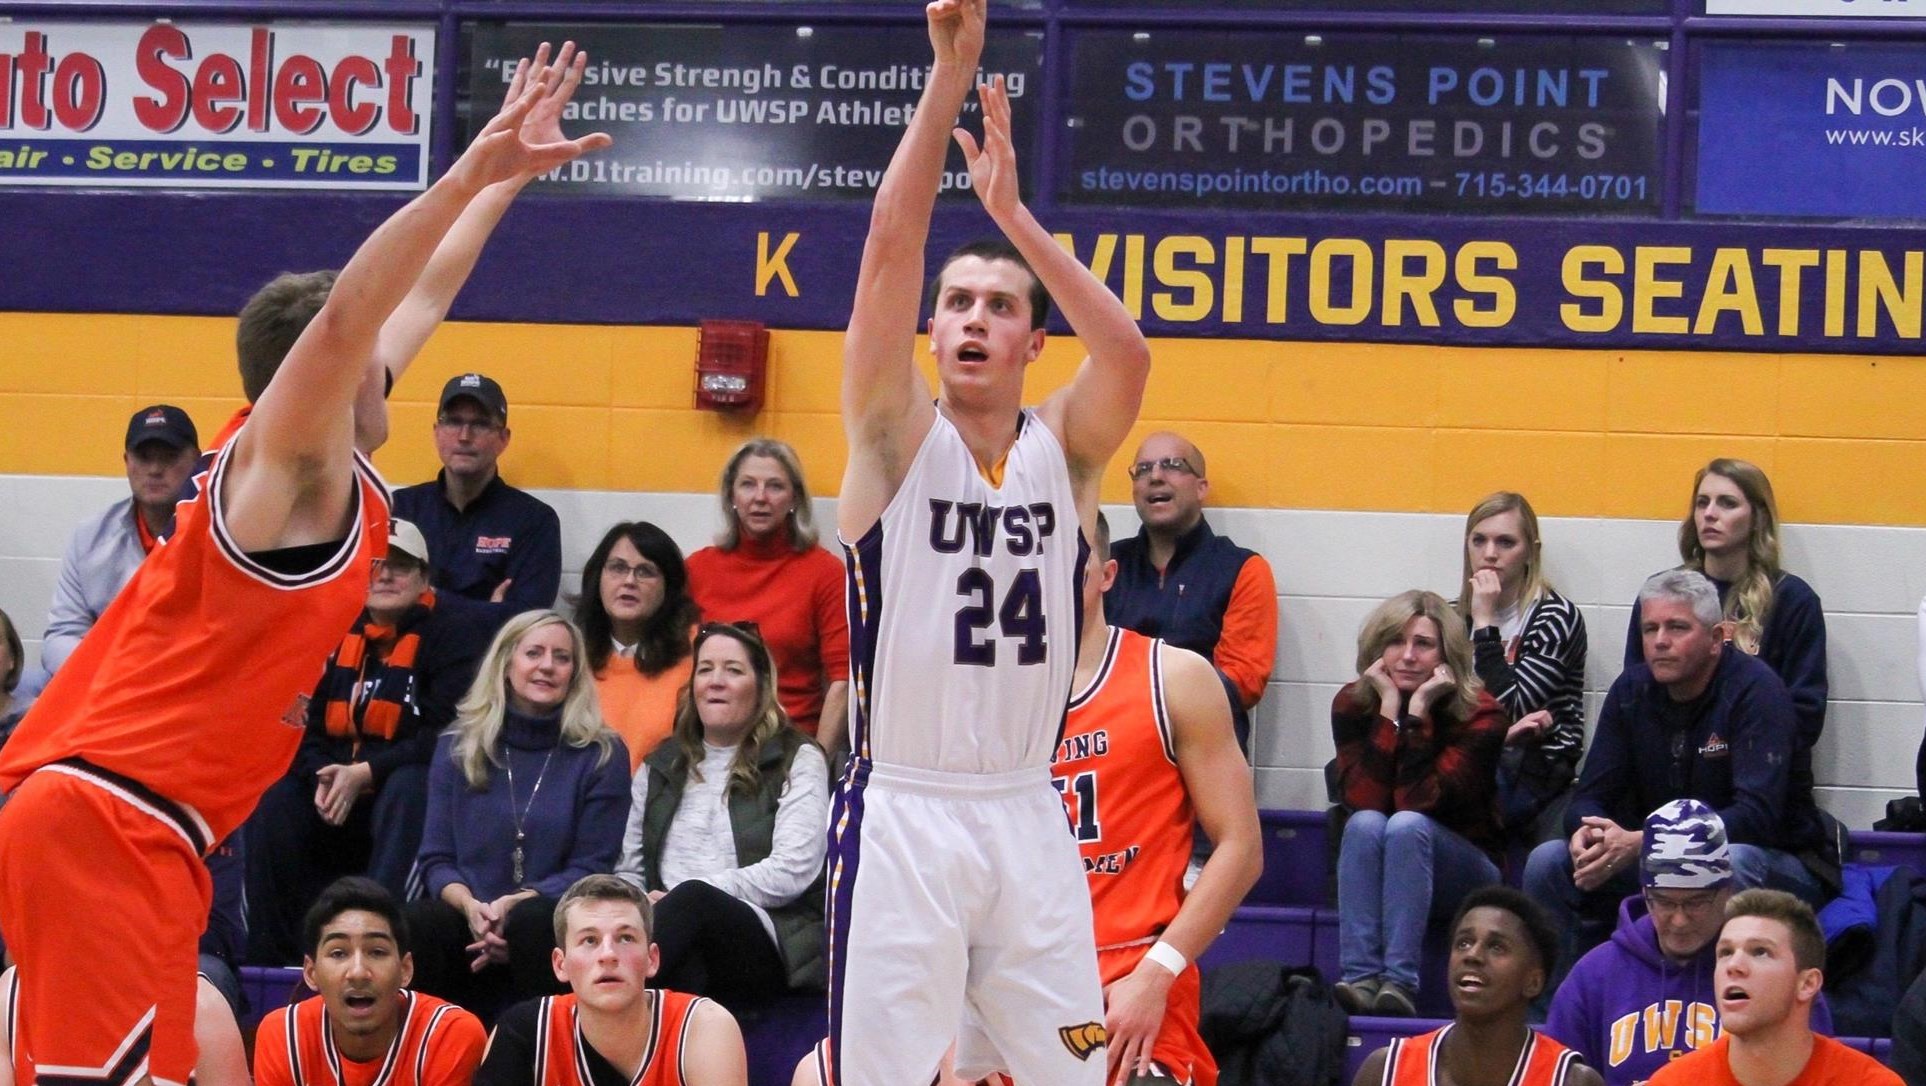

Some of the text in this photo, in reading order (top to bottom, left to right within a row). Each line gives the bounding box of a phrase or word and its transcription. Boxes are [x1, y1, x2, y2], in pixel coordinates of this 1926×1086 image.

[0, 23, 422, 135] to Select
[655, 62, 781, 94] Strengh
[790, 65, 812, 88] &
[820, 65, 1025, 97] Conditiing
[1124, 62, 1608, 107] STEVENS POINT
[1826, 77, 1926, 116] NO
[562, 96, 653, 121] aches
[662, 97, 709, 122] for
[716, 99, 808, 124] UWSP
[1122, 114, 1606, 160] ORTHOPEDICS
[1825, 126, 1926, 147] www.sk
[86, 146, 247, 171] Service
[291, 148, 397, 174] Tires
[1081, 166, 1422, 197] stevenspointortho.com
[1455, 172, 1647, 199] 715-344-0701
[755, 232, 800, 297] K
[1052, 233, 1926, 339] VISITORS SEATIN
[929, 498, 1056, 558] UWSP
[953, 567, 1047, 667] 24
[1050, 731, 1108, 763] ING
[1608, 999, 1722, 1068] UWS
